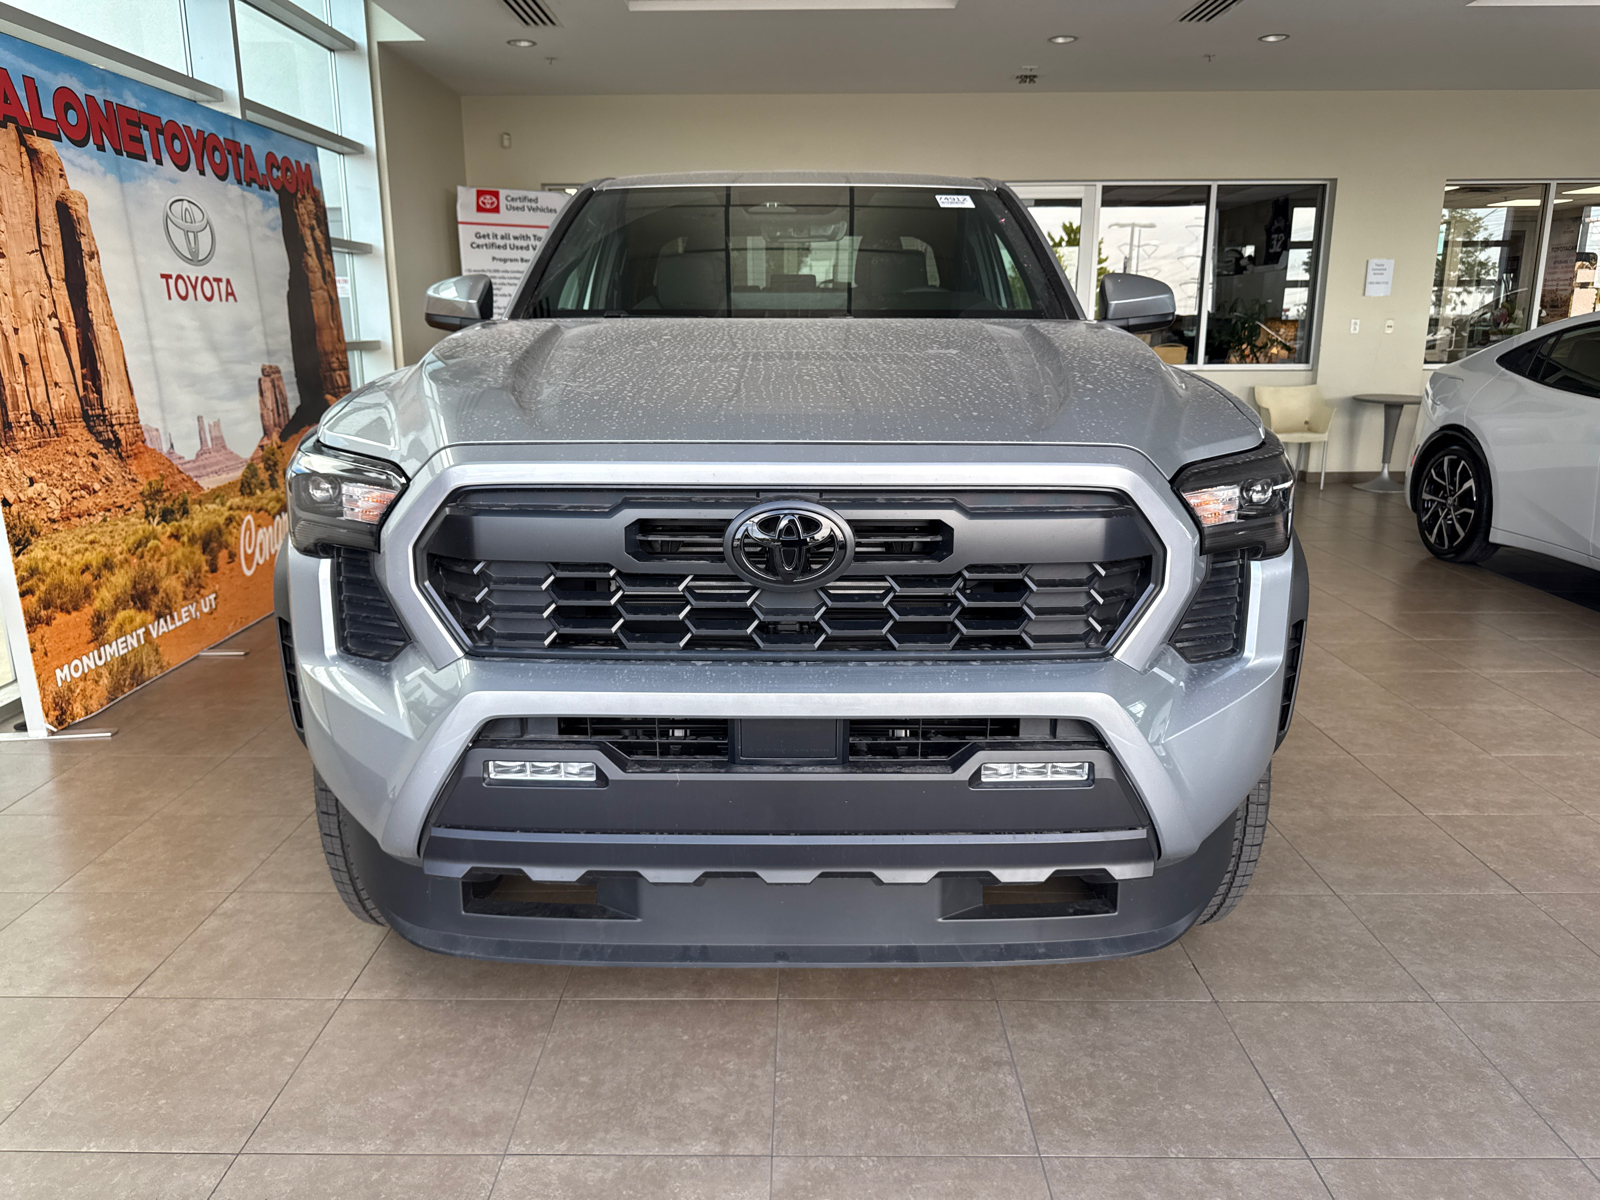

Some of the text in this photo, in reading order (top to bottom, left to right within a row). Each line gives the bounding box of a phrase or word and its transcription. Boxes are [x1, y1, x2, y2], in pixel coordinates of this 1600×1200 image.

[505, 194, 538, 204] Certified
[505, 204, 557, 214] Used Vehicles
[474, 231, 490, 240] Get
[491, 232, 499, 240] it
[500, 232, 511, 240] all
[512, 233, 531, 241] with
[470, 241, 507, 250] Certified
[508, 242, 530, 251] Used
[160, 273, 238, 303] TOYOTA
[55, 592, 217, 687] MONUMENT VALLEY, UT
